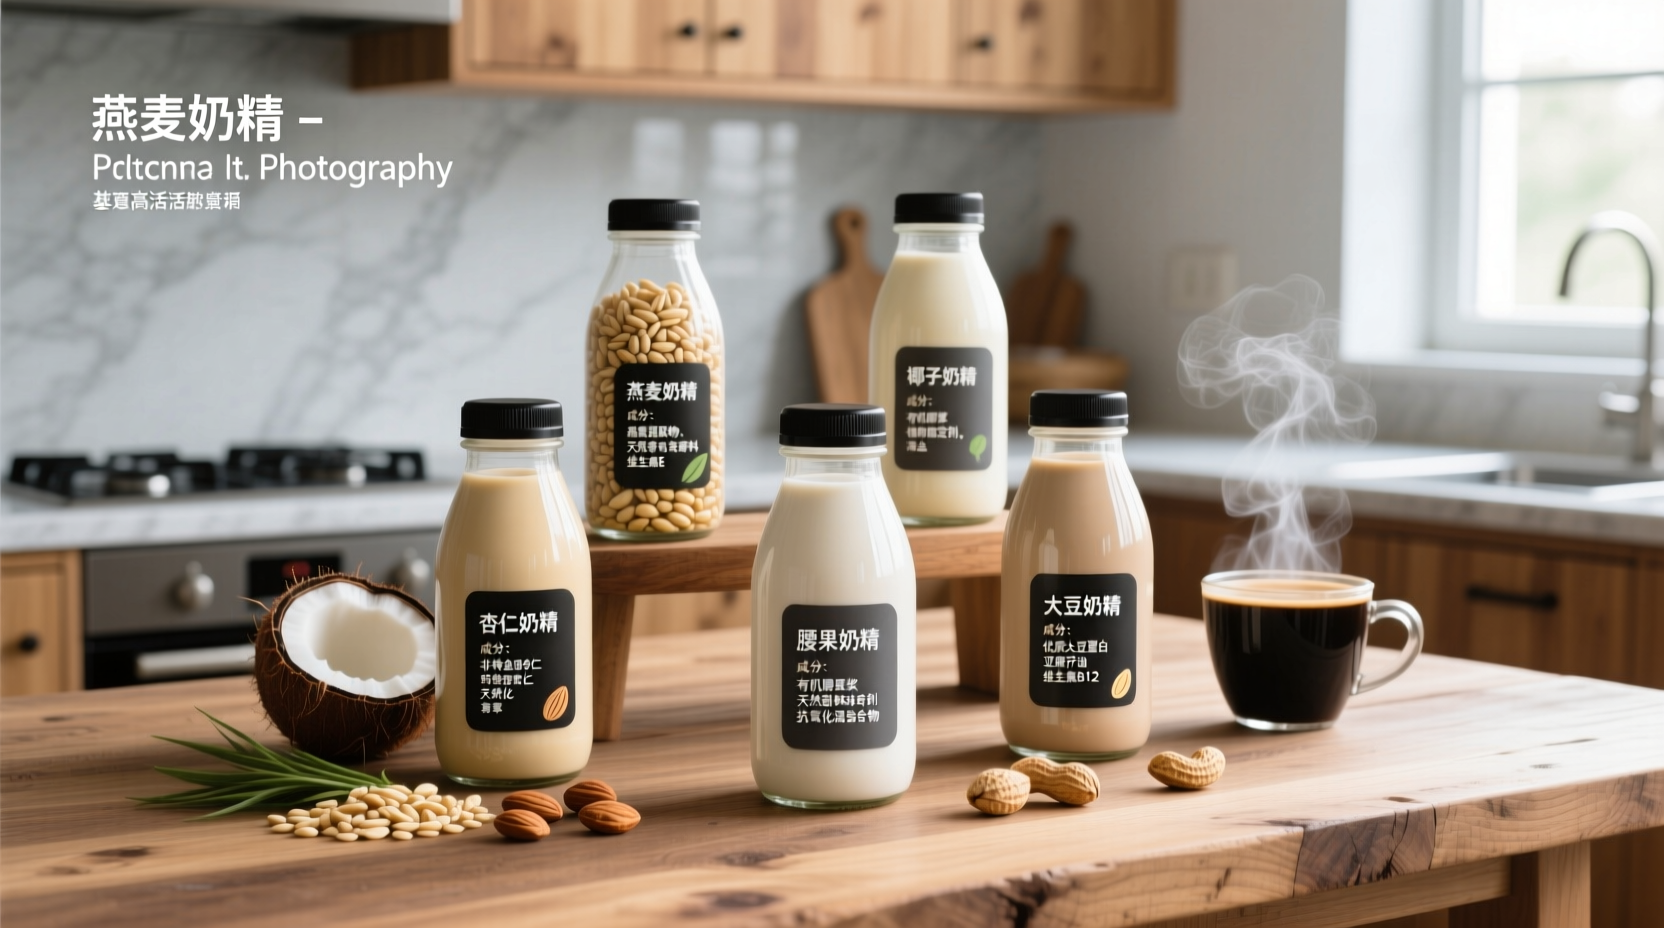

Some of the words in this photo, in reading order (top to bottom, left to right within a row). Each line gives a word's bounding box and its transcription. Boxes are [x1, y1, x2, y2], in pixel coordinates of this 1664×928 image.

[907, 366, 977, 386] 椰子奶精
[627, 381, 697, 401] 燕麦奶精
[1044, 595, 1121, 616] 大豆奶精
[479, 611, 558, 634] 杏仁奶精
[796, 628, 880, 652] 腰果奶精
